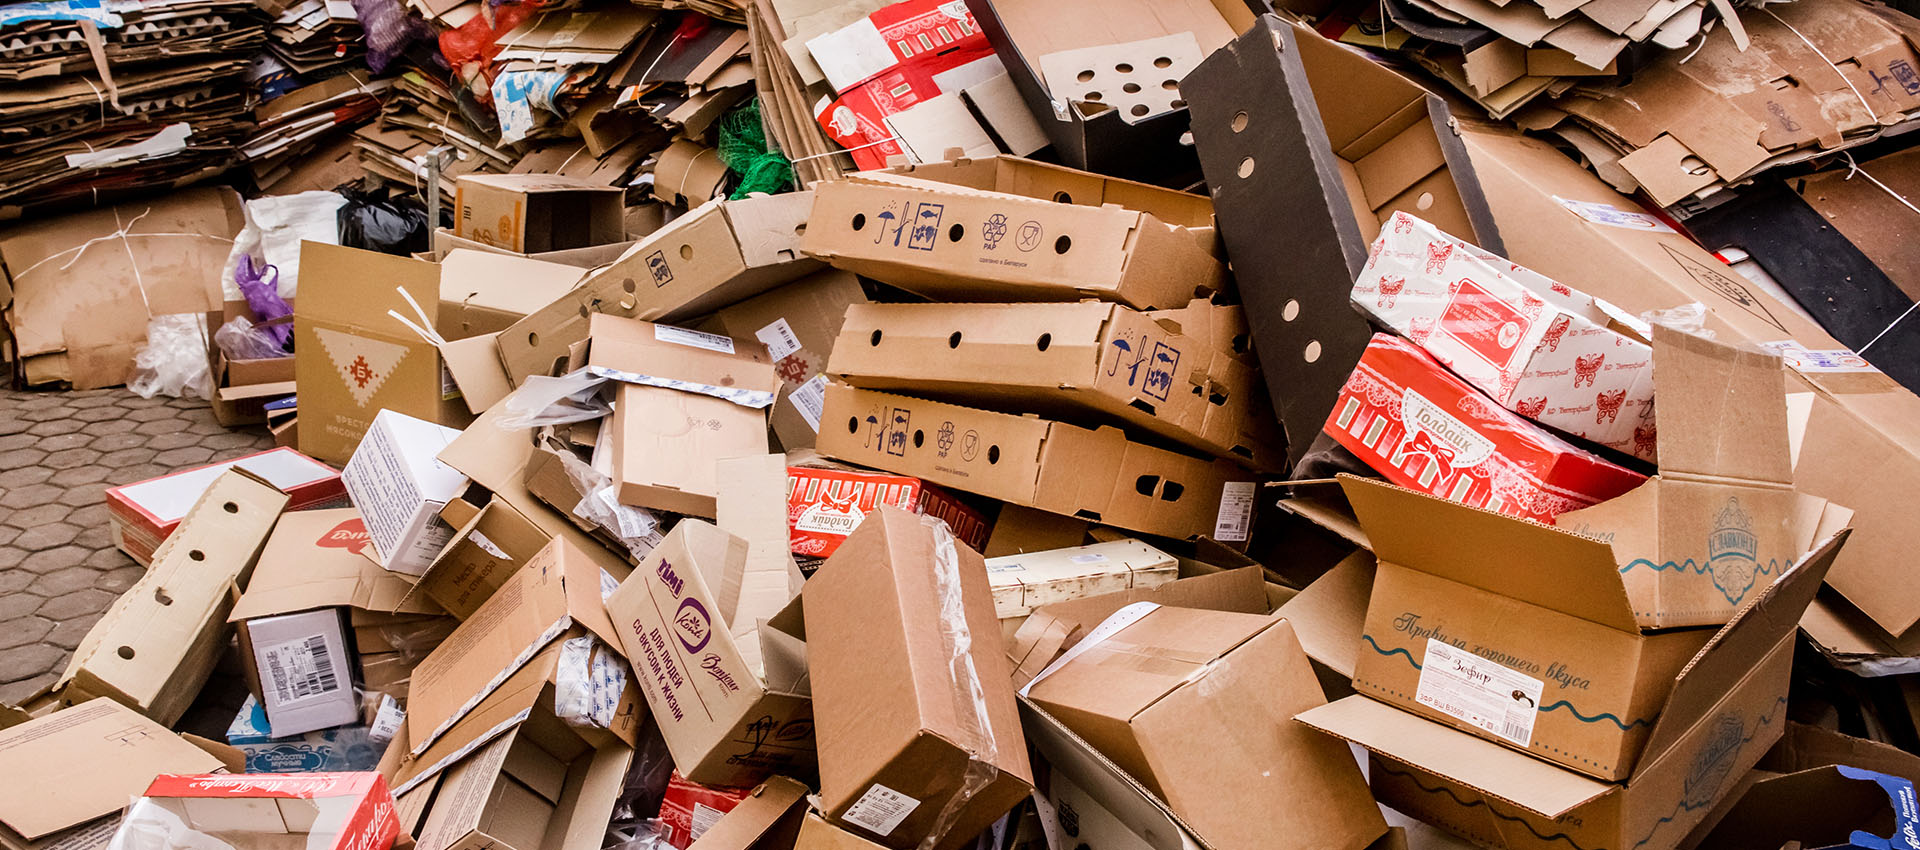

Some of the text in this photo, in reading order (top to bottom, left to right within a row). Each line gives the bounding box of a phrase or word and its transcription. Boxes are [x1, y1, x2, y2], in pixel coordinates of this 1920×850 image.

[357, 366, 367, 379] Б
[1414, 407, 1473, 453] Голдайк
[331, 529, 369, 540] ика
[453, 562, 477, 586] Место
[676, 612, 703, 639] Konti
[649, 627, 685, 689] ДЛЯ ЛЮДЕЙ
[1393, 612, 1466, 650] Правила
[1469, 643, 1540, 674] хорошего
[1544, 662, 1591, 690] вкуса
[632, 618, 685, 723] СО ВКУСОМ К ЖИЗНИ
[700, 652, 740, 694] Bonjour
[1452, 658, 1494, 685] Зефир
